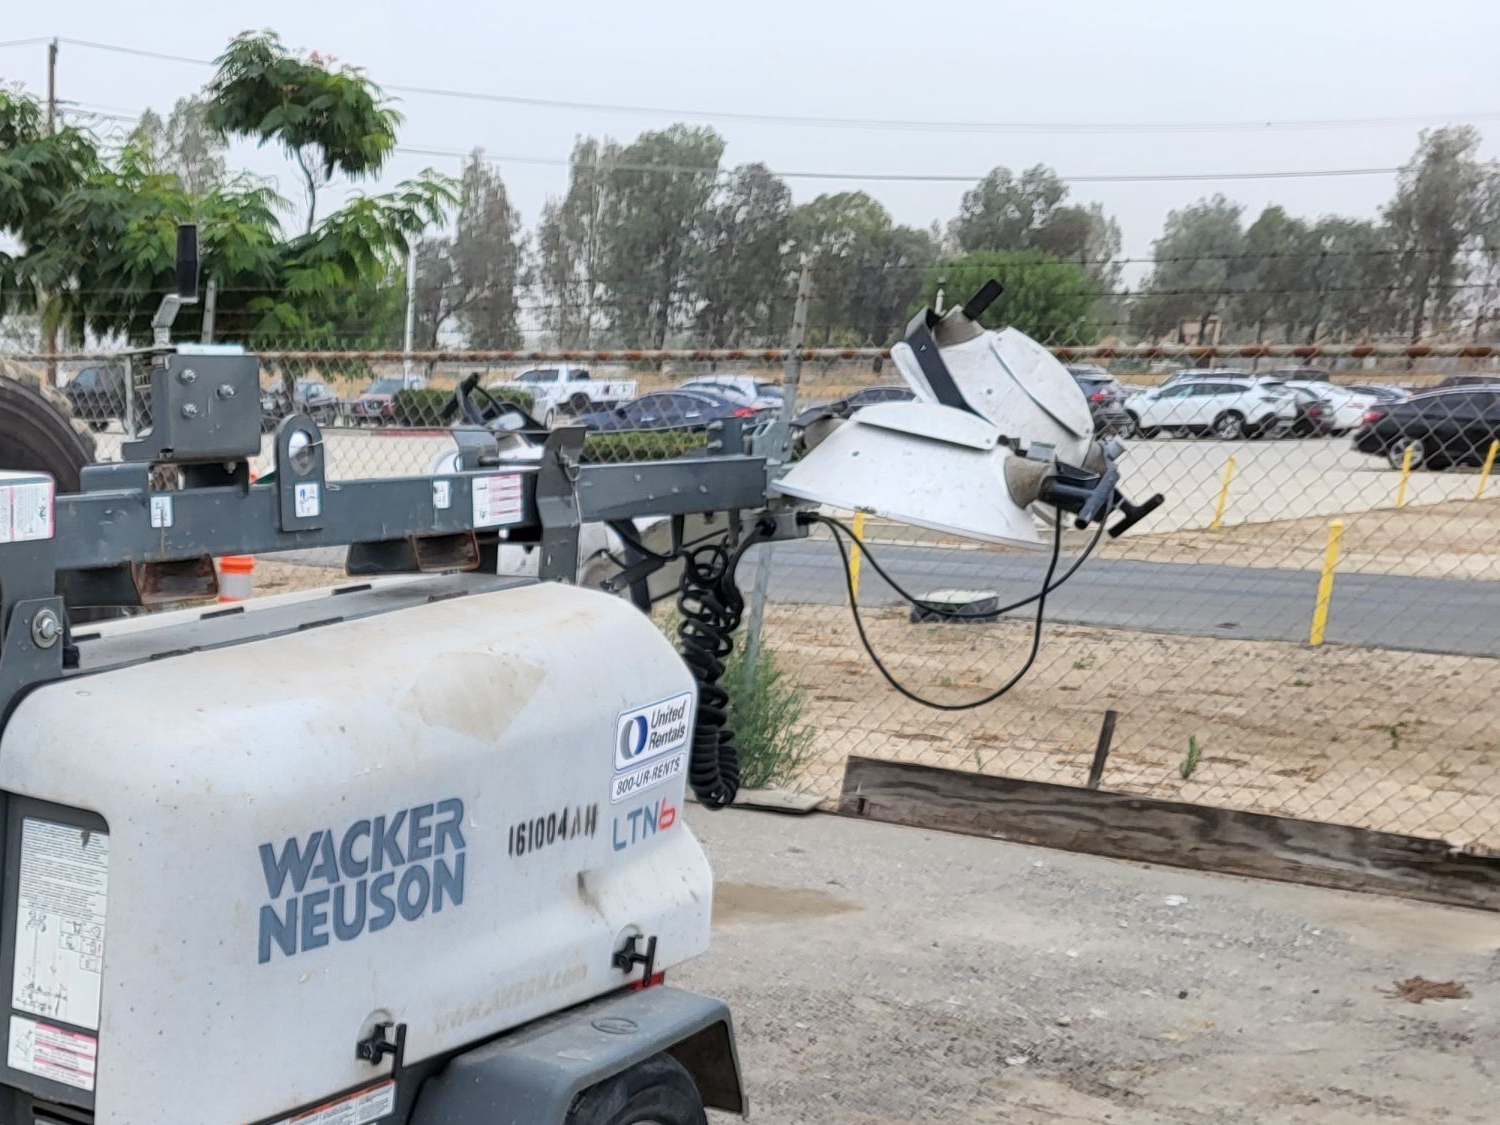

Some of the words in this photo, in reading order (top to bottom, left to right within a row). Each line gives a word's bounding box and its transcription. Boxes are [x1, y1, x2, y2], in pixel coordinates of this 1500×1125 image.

[648, 721, 685, 751] Rentals
[650, 700, 686, 728] United
[616, 756, 681, 796] 800-UR-RENTS
[613, 797, 676, 851] LTN6
[258, 798, 466, 899] WACKER
[258, 852, 466, 964] NEUSON
